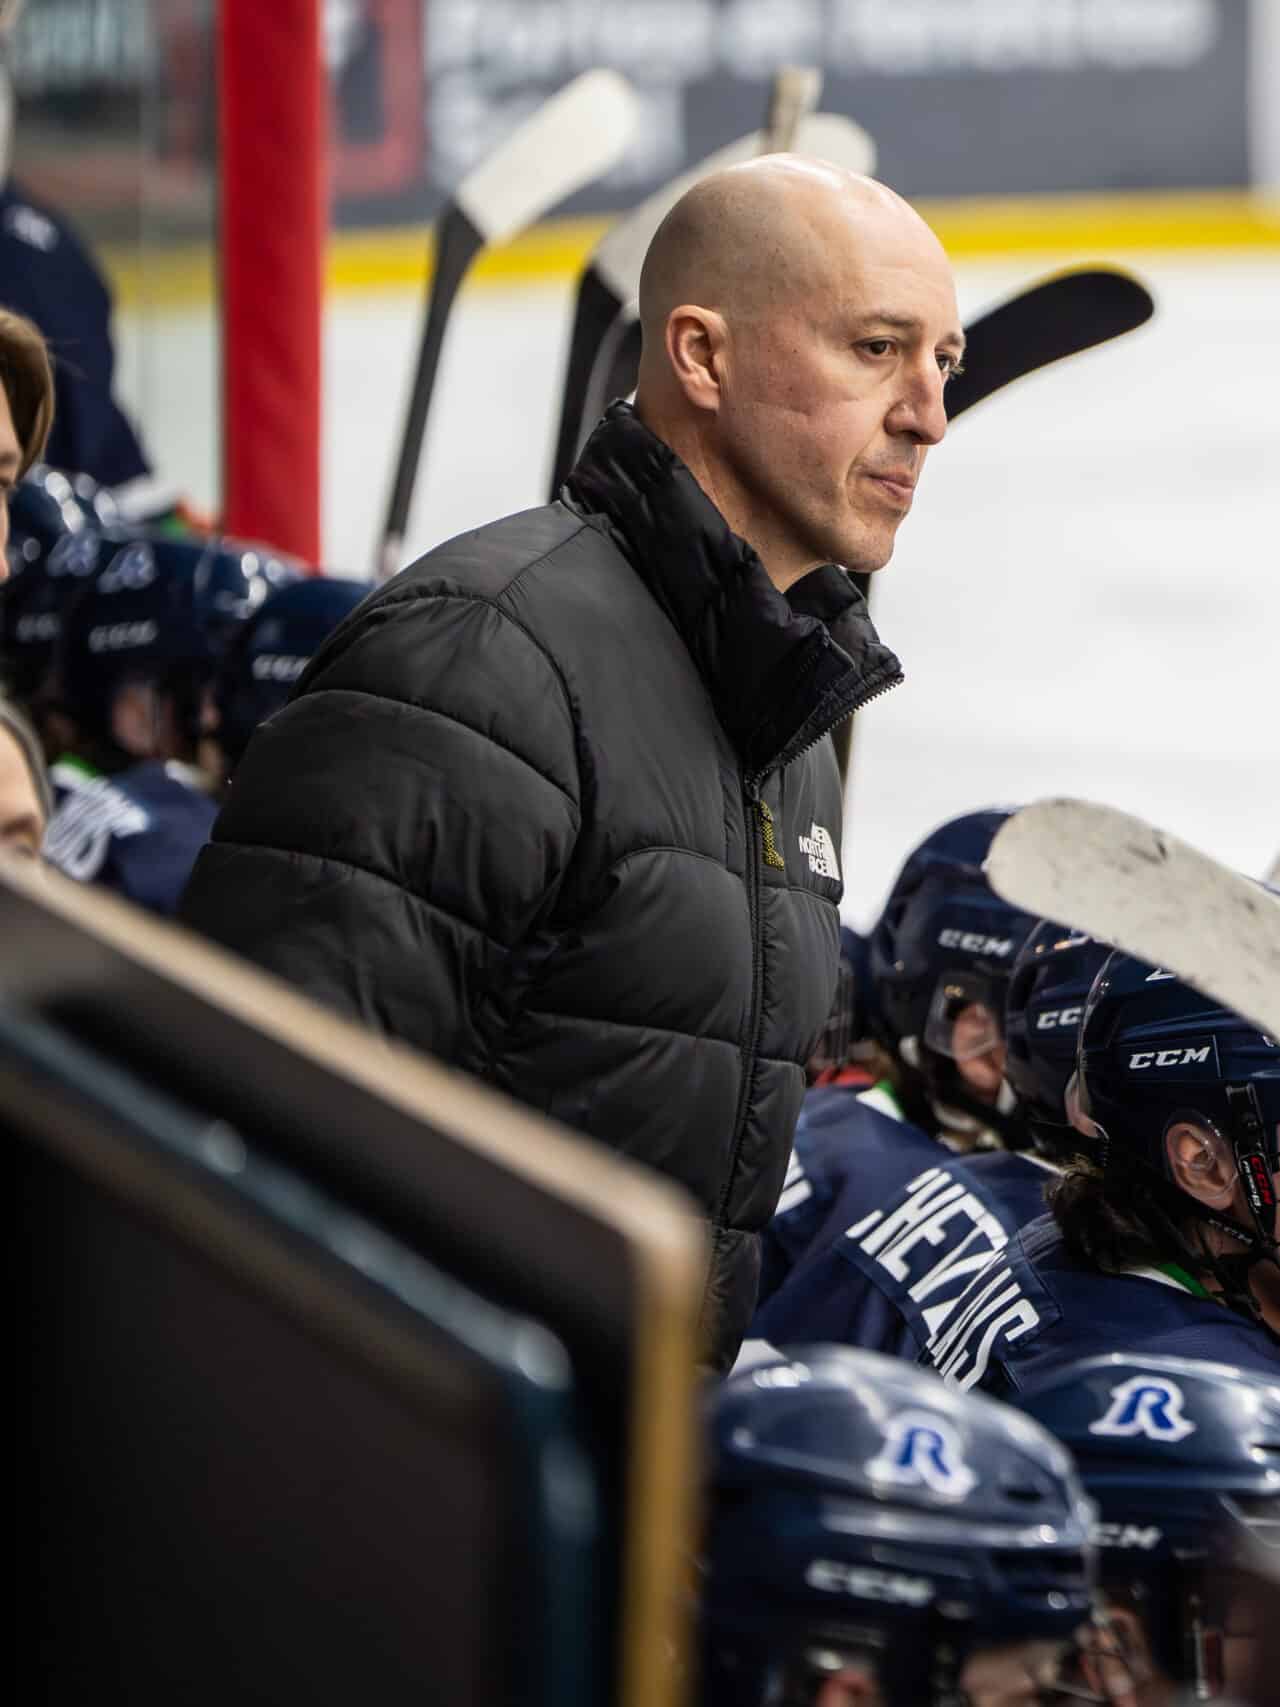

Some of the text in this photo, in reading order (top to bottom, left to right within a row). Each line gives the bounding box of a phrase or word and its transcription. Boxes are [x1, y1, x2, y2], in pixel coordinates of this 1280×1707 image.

[938, 928, 1013, 958] CCM
[1037, 1007, 1083, 1030] CC
[1128, 1046, 1211, 1069] CCM
[1090, 1377, 1197, 1442] R
[864, 1408, 978, 1500] R
[1089, 1523, 1162, 1550] CM
